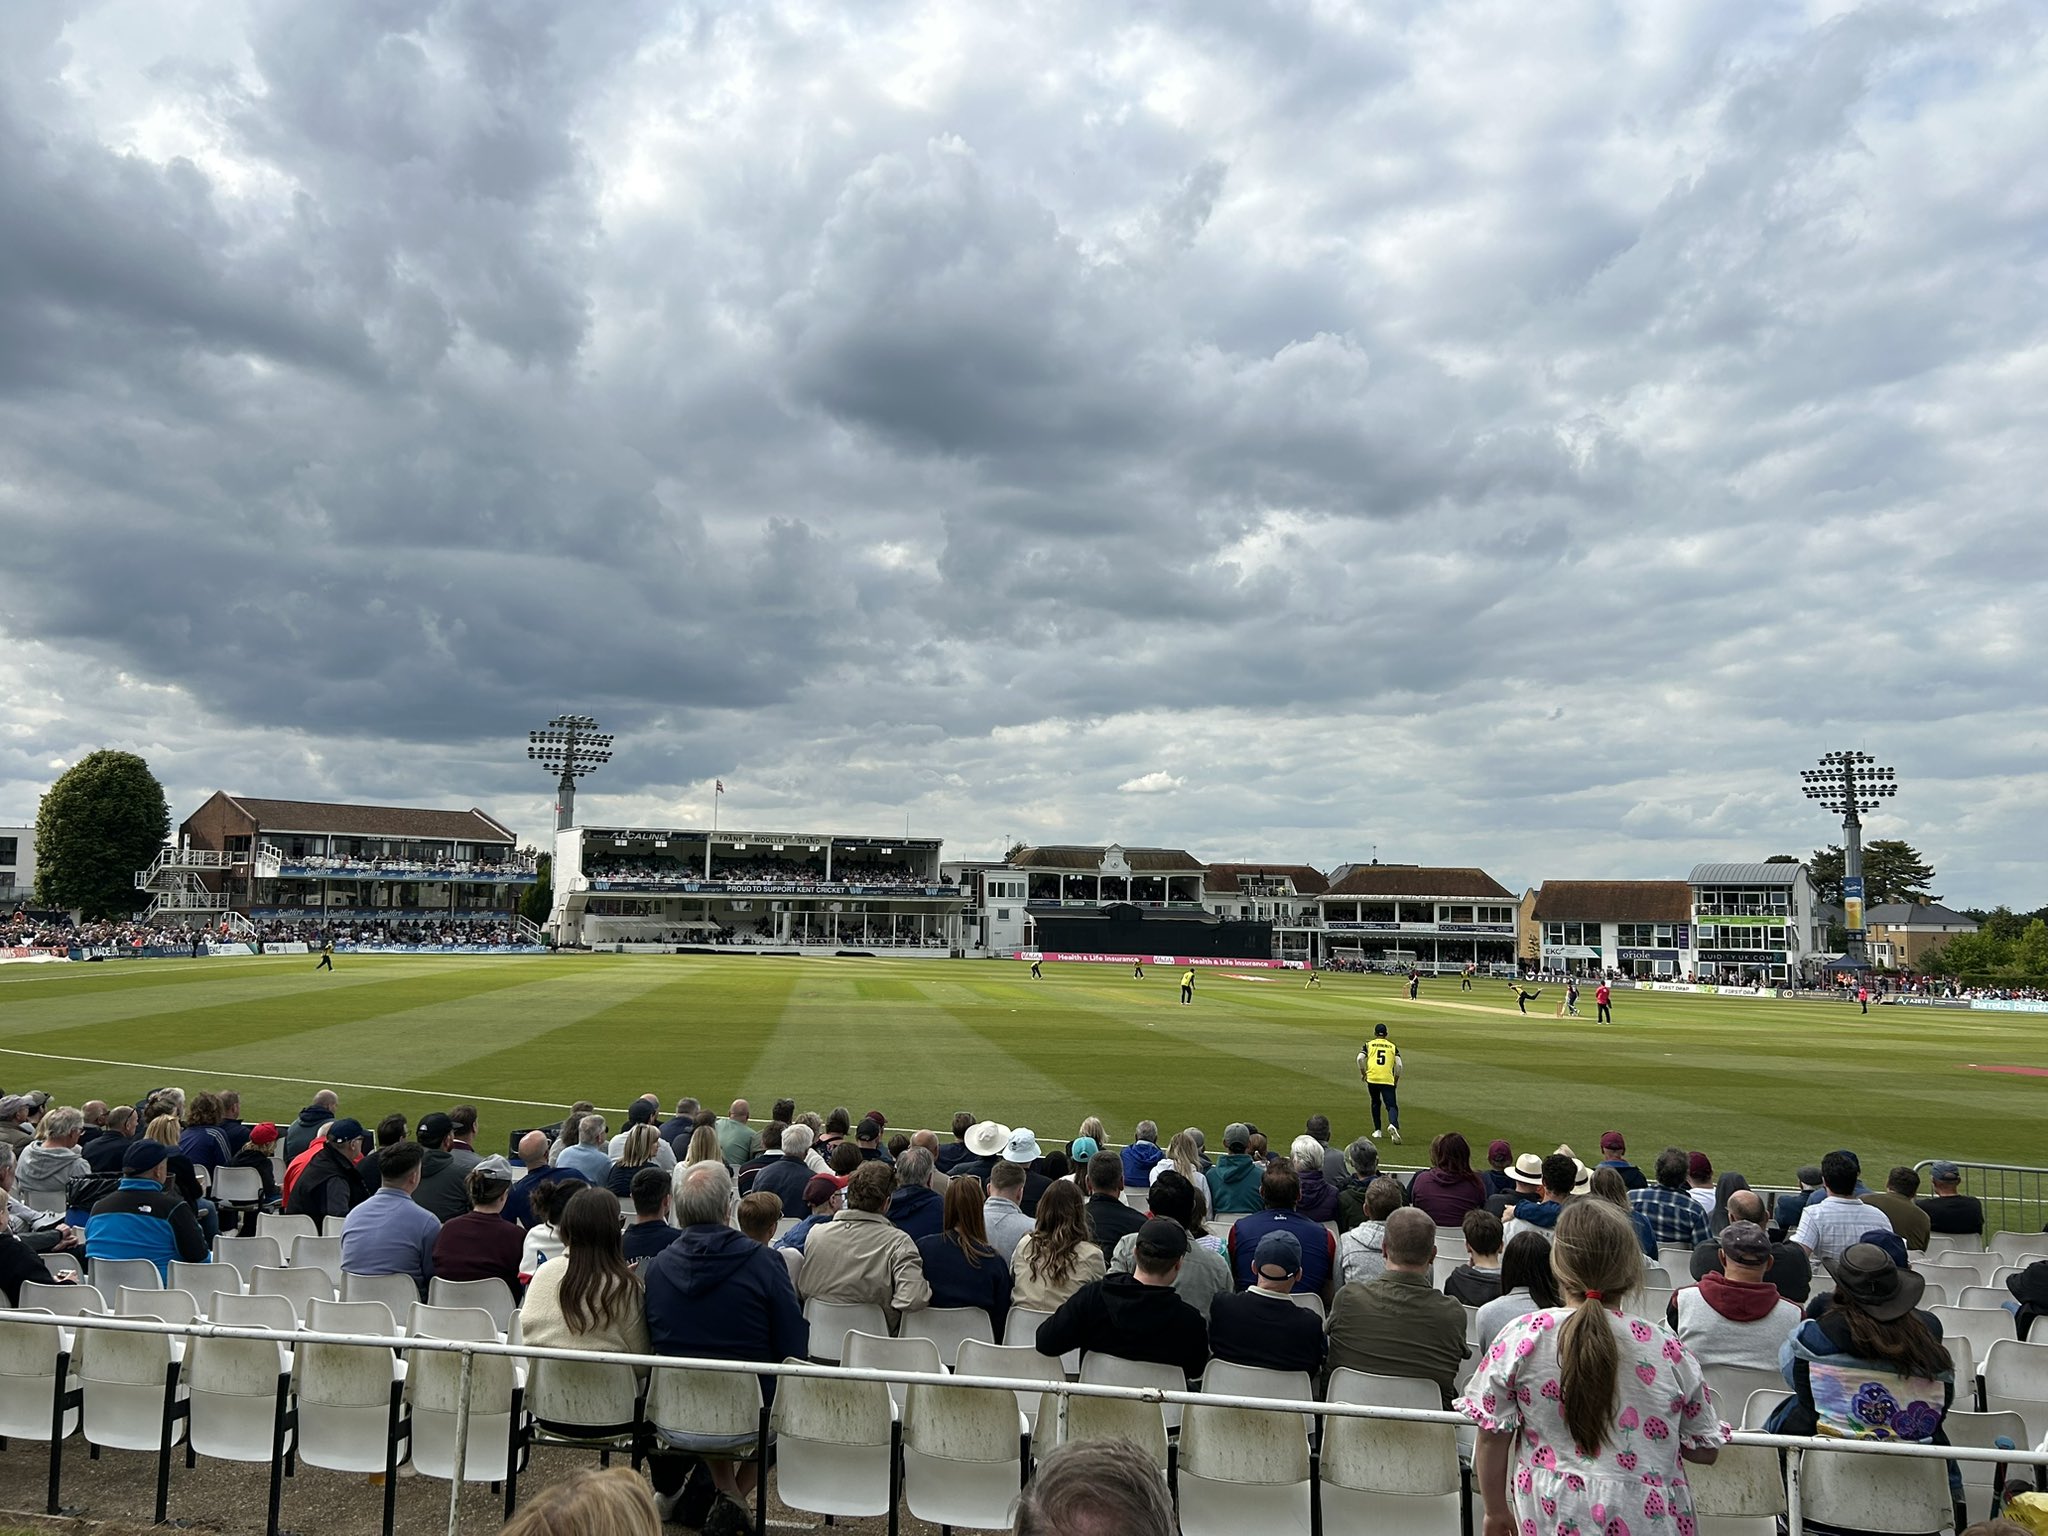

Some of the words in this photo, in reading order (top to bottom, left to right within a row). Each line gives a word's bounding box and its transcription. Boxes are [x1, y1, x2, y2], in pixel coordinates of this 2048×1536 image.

[609, 831, 666, 841] ALCALINE
[303, 867, 333, 878] Spitfire
[354, 869, 382, 878] Spitfire
[402, 870, 429, 879] Spitfire
[449, 872, 475, 881] Spitfire
[493, 873, 518, 882] Spitfire
[726, 885, 751, 893] PROUD
[752, 885, 762, 893] TO
[763, 885, 796, 894] SUPPORT
[796, 886, 815, 894] KENT
[815, 886, 845, 894] CRICKET
[275, 907, 305, 918] Spitfire
[327, 908, 356, 919] Spitfire
[375, 909, 403, 919] Spitfire
[422, 909, 449, 919] Spitfire
[1329, 922, 1348, 930] CCCU
[1438, 924, 1459, 932] CCCU
[344, 942, 372, 951] Spitfire
[381, 943, 407, 952] Spitfire
[416, 943, 443, 952] Spitfire
[452, 944, 478, 952] Spitfire
[487, 944, 512, 953] Spitfire
[520, 943, 547, 953] Spitfire
[1545, 947, 1561, 955] EKC
[1057, 953, 1083, 961] Health
[1089, 954, 1103, 962] Life
[1104, 955, 1139, 963] Insurance
[1622, 950, 1650, 960] oriole
[1189, 957, 1213, 965] Health
[1219, 958, 1234, 966] Life
[1234, 959, 1269, 967] Insurance
[1537, 974, 1580, 985] CASTOE
[1973, 1000, 2010, 1011] Barretts
[1376, 1049, 1386, 1066] 5
